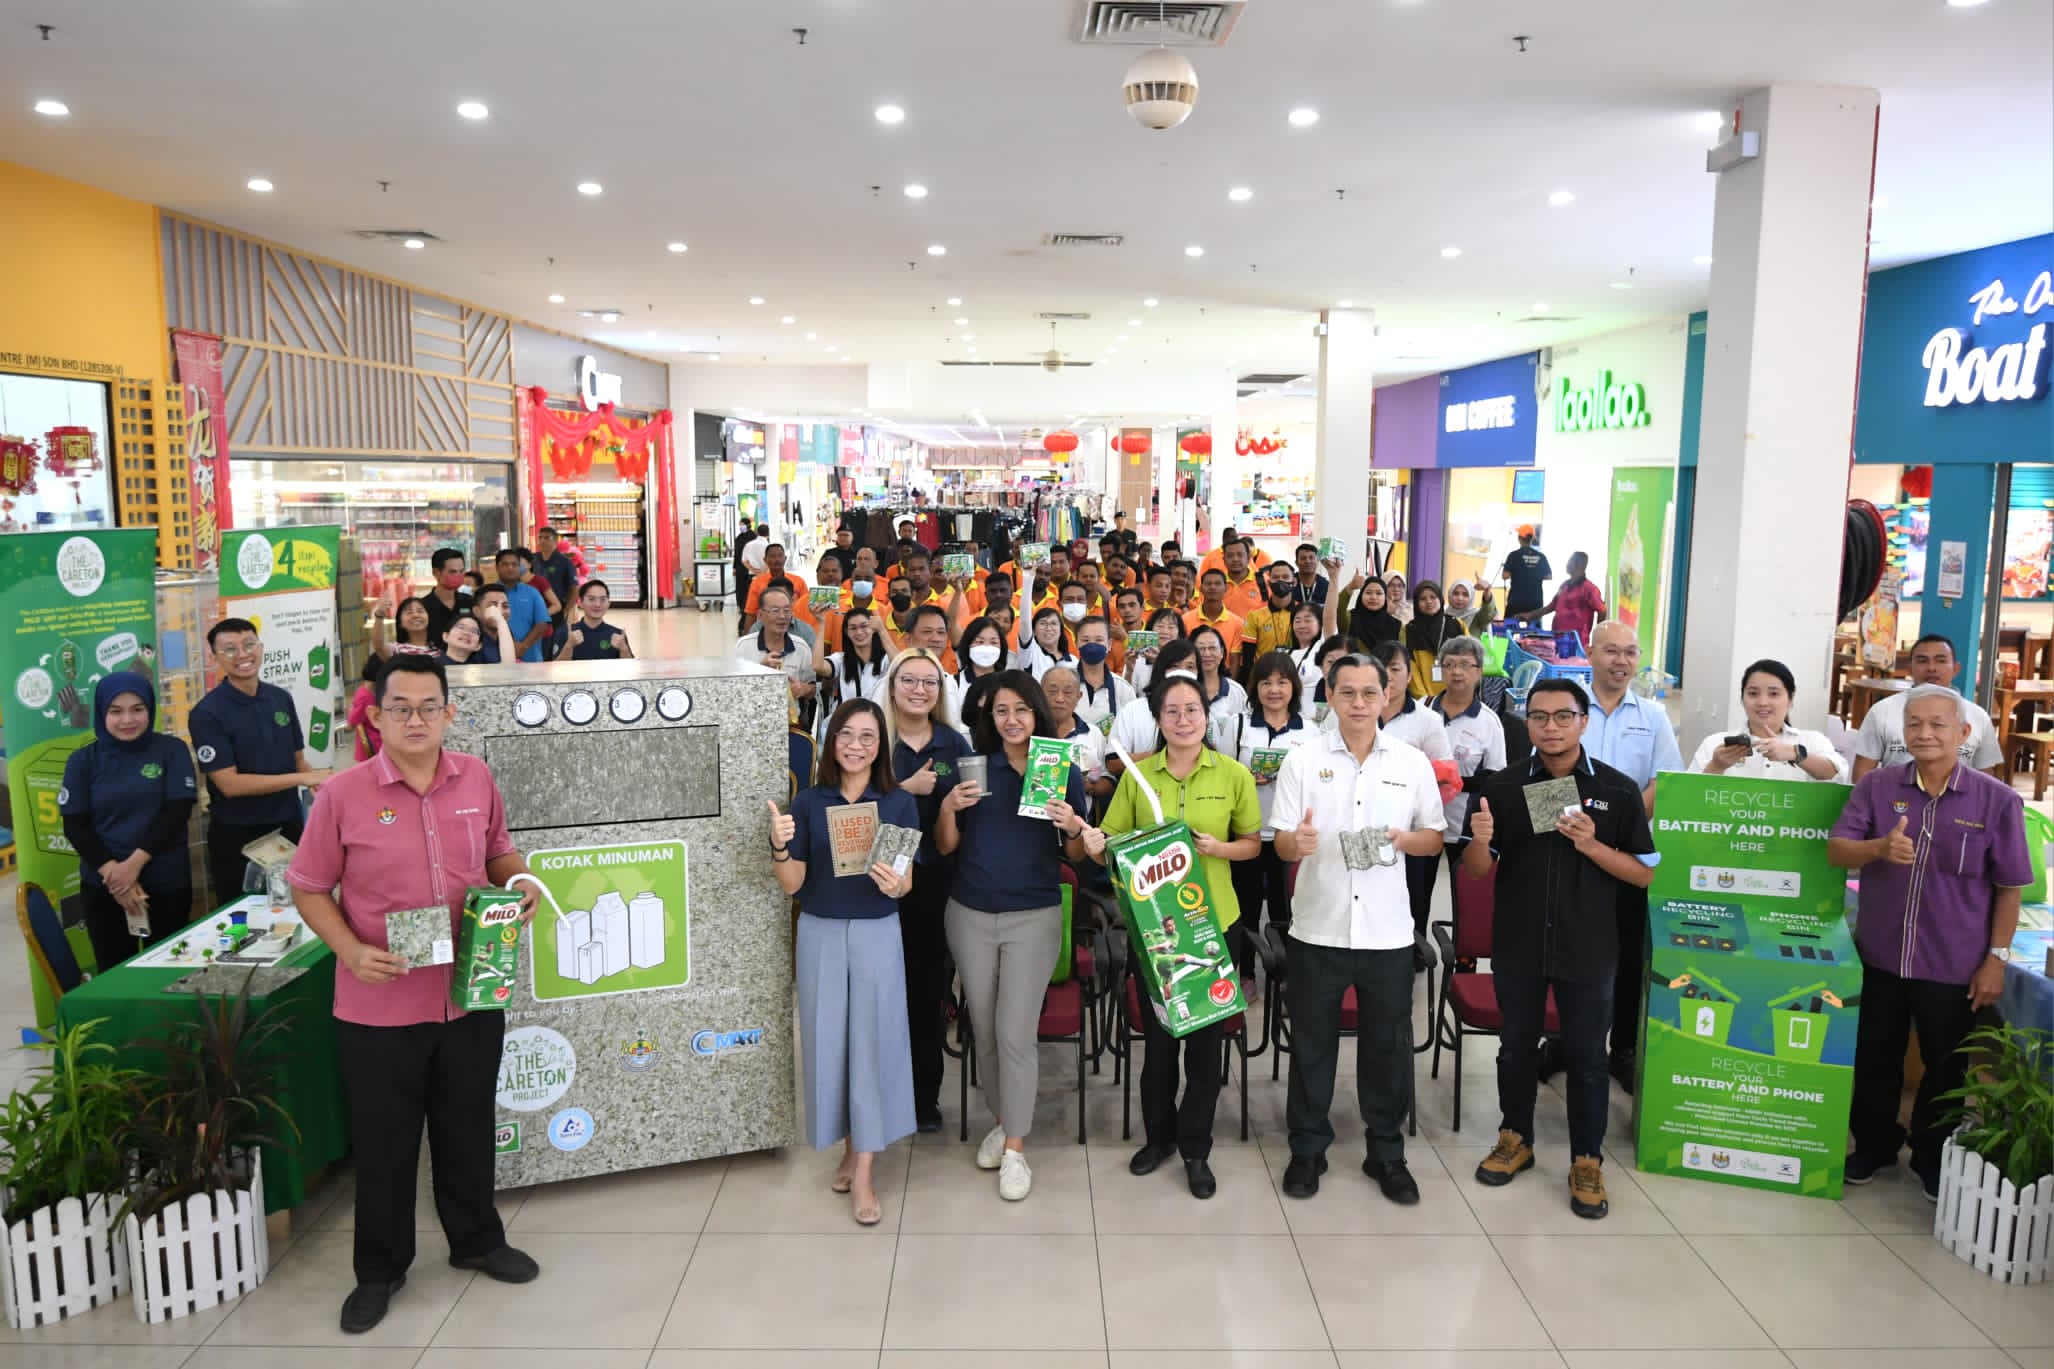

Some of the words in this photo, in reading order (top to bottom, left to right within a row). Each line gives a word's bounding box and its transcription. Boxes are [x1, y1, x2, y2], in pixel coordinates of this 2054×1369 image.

[1922, 322, 2046, 407] Boat
[278, 540, 296, 577] 4
[264, 648, 290, 664] PUSH
[263, 661, 303, 679] STRAW
[1704, 789, 1796, 809] RECYCLE
[840, 816, 872, 827] USED
[1729, 809, 1767, 820] YOUR
[844, 827, 861, 839] BE
[1658, 819, 1734, 834] BATTERY
[1736, 824, 1775, 838] AND
[1779, 826, 1829, 841] PHON
[48, 834, 73, 849] 202
[1730, 841, 1766, 853] HERE
[542, 854, 593, 870] KOTAK
[597, 848, 674, 865] MINUMAN
[1138, 853, 1187, 890] MILO
[1661, 906, 1735, 919] RECYCLING
[1667, 901, 1728, 911] BATTERY
[484, 908, 517, 922] MILO
[1687, 914, 1711, 922] BIN
[1770, 911, 1819, 921] PHONE
[1759, 916, 1835, 929] RECYCLING
[1787, 924, 1811, 932] BIN
[514, 1051, 544, 1071] THE
[1712, 1056, 1787, 1079] RECYCLE
[1732, 1073, 1764, 1084] YOUR
[512, 1088, 549, 1103] PROJECT
[1672, 1074, 1735, 1092] BATTERY
[1737, 1083, 1770, 1096] AND
[1773, 1087, 1825, 1104] PHONE
[1731, 1094, 1762, 1105] HERE
